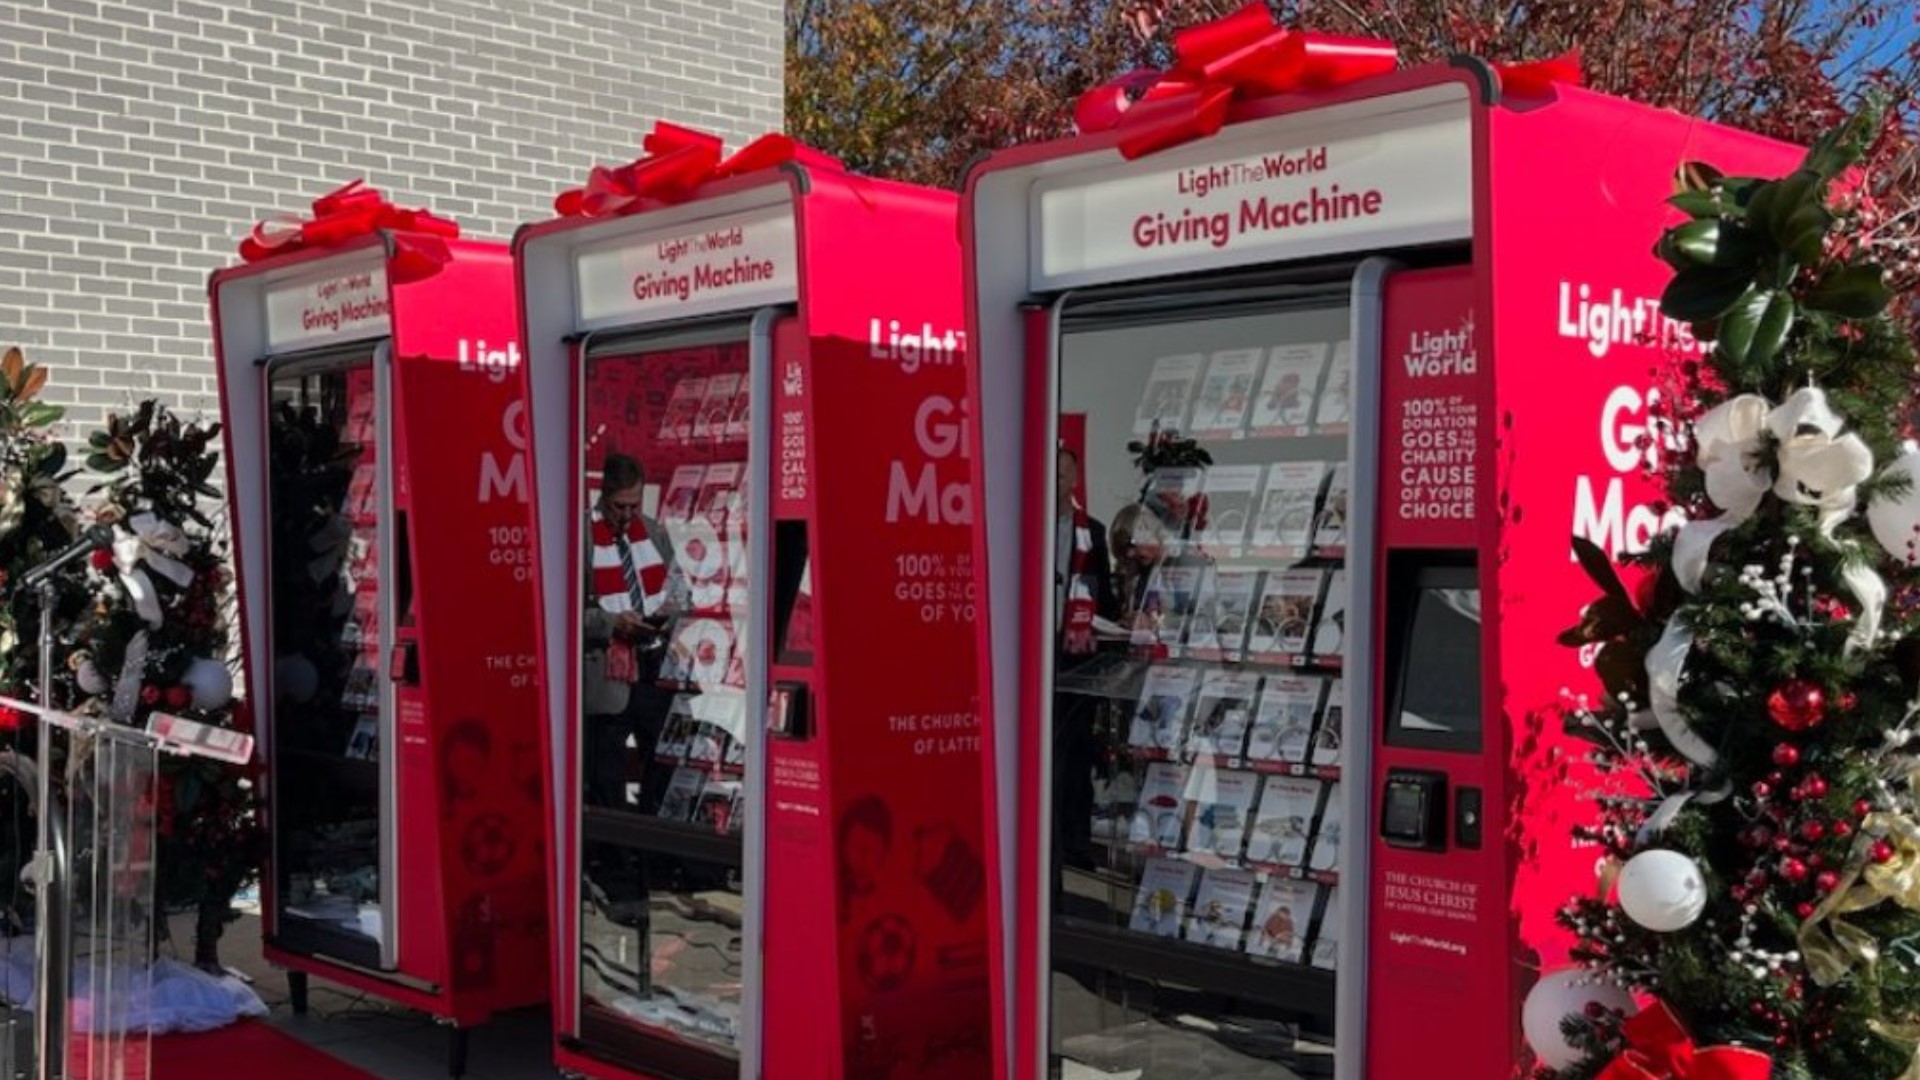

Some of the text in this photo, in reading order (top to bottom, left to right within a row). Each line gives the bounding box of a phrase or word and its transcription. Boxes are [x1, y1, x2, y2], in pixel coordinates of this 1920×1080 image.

[1178, 146, 1328, 197] LightTheWorld
[1133, 184, 1383, 248] Giving Machine
[634, 256, 773, 301] Giving Machine
[303, 306, 338, 331] Giving
[1411, 329, 1467, 357] Light
[1403, 350, 1478, 377] World
[1402, 399, 1448, 416] 100%
[1402, 415, 1478, 431] DONATION
[1402, 430, 1458, 448] GOES
[1401, 449, 1476, 465] CHARITY
[1400, 466, 1475, 485] CAUSE
[1400, 486, 1474, 501] OF YOUR
[1400, 503, 1475, 519] CHOICE
[896, 554, 946, 577] 100%
[895, 581, 946, 600] GOES
[921, 604, 945, 623] OF
[486, 656, 512, 670] THE
[889, 715, 916, 731] THE
[914, 739, 934, 755] OF
[1385, 871, 1478, 894] THE CHURCH OF
[1385, 884, 1479, 911] JESUS CHRIST
